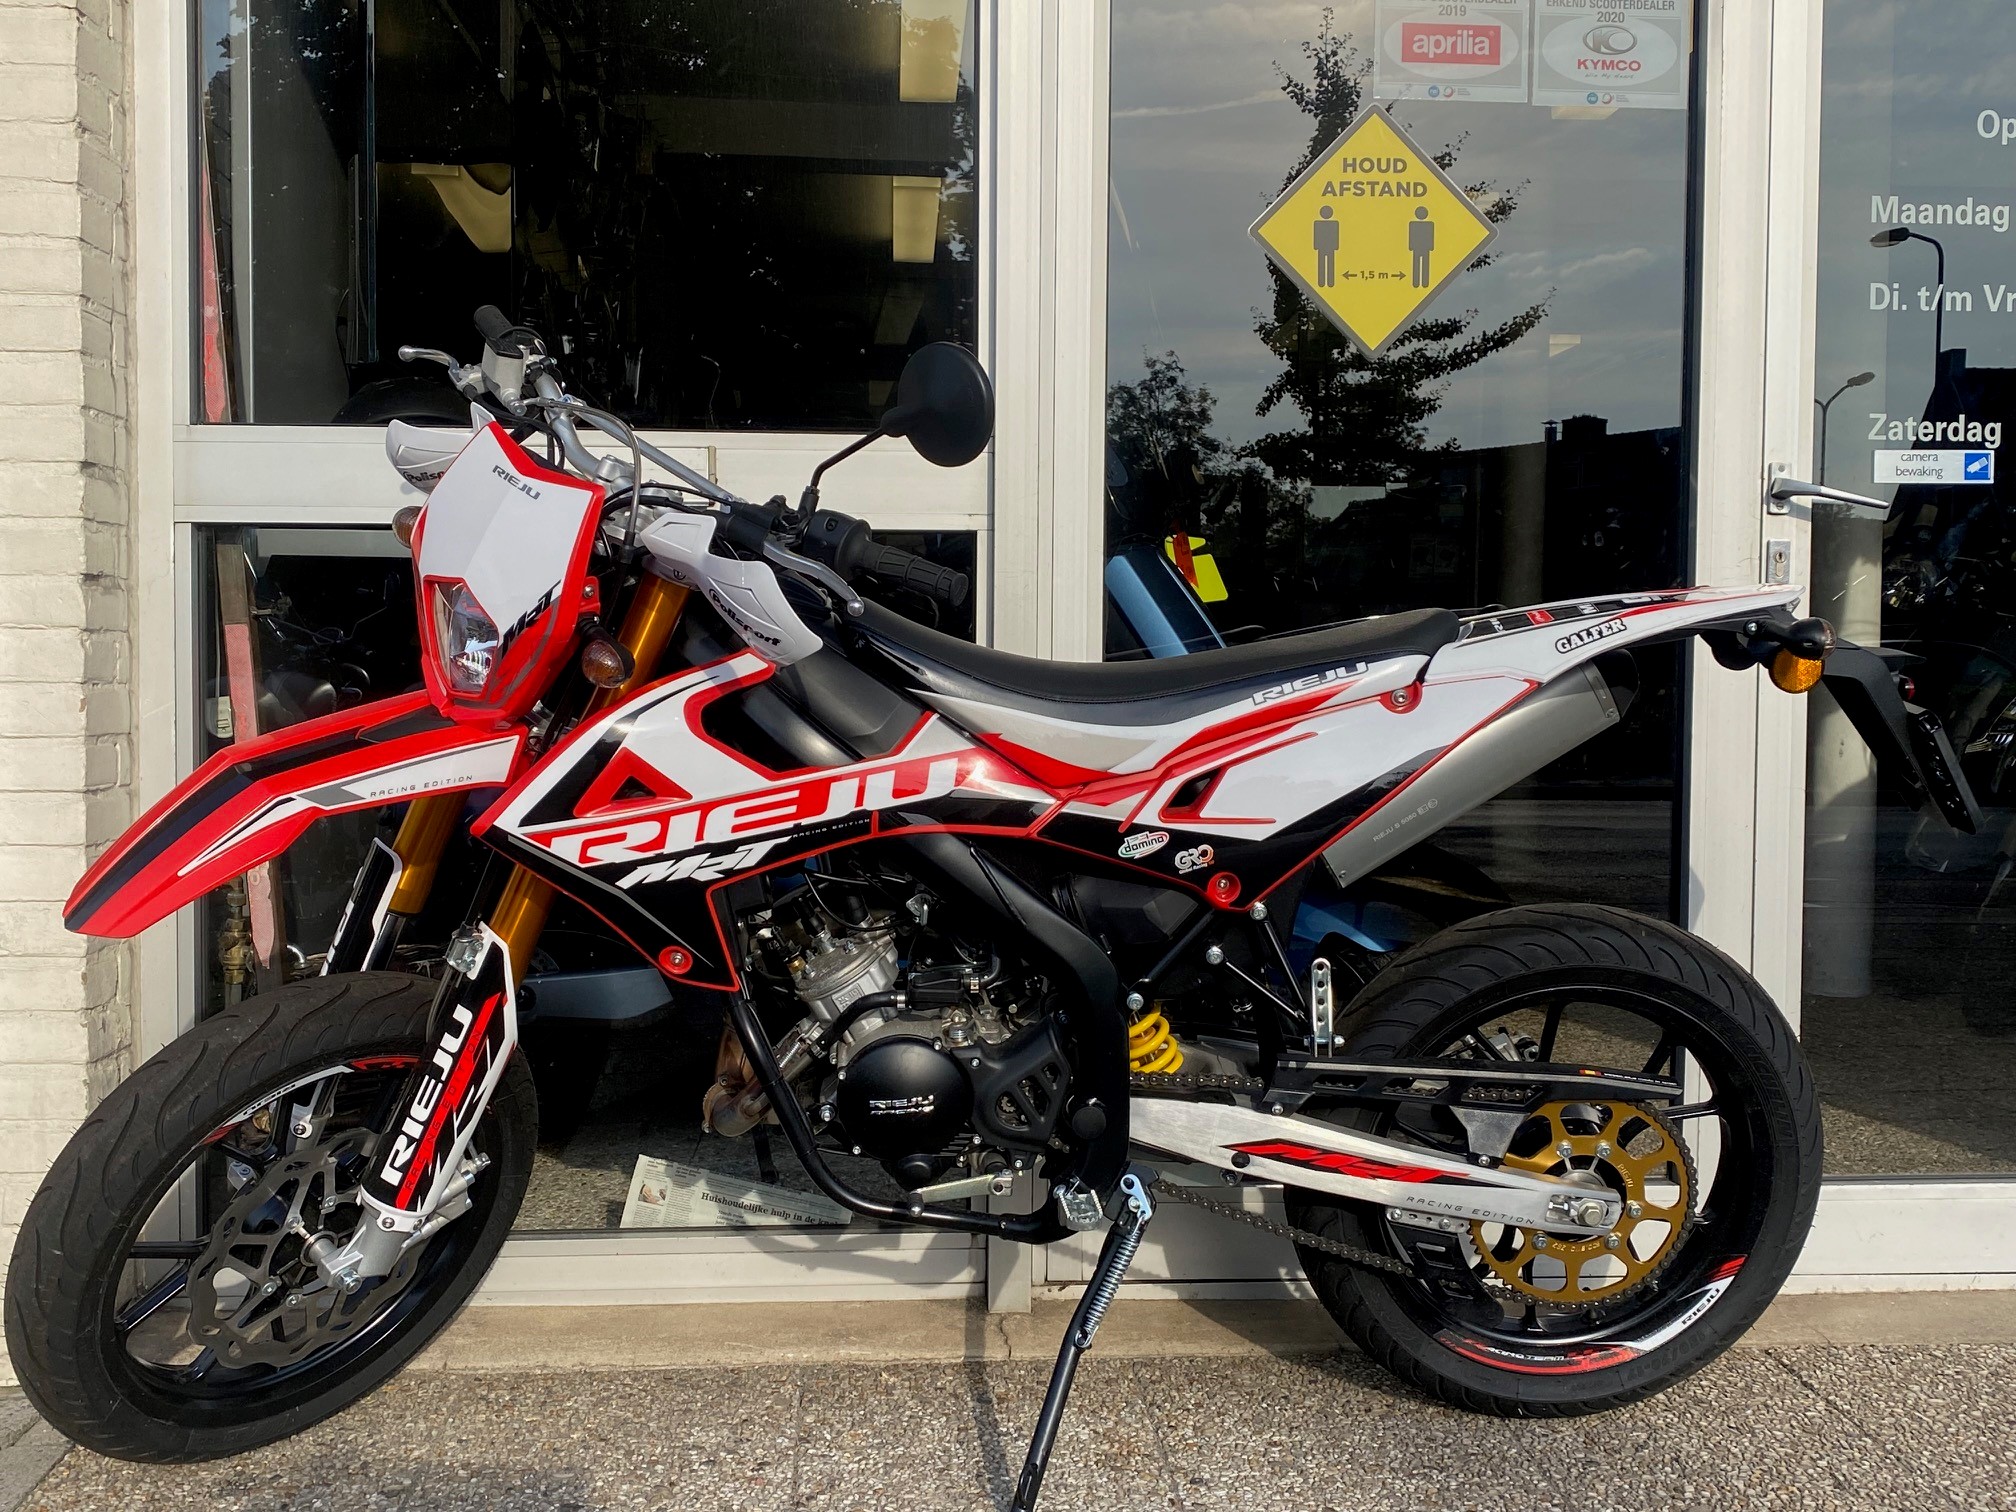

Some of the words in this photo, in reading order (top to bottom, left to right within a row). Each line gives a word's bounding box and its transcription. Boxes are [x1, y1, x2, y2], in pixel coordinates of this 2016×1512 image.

[1438, 4, 1467, 17] 2019
[1588, 0, 1675, 11] SCOOTERDEALER
[1596, 11, 1625, 23] 2020
[1412, 29, 1490, 58] aprilia
[1577, 58, 1642, 72] KYMCO
[1342, 157, 1408, 174] HOUD
[1321, 181, 1428, 198] AFSTAND
[1870, 195, 2010, 232] Maandag
[1360, 270, 1375, 280] 1,5
[1378, 271, 1389, 280] m
[1869, 282, 1908, 311] Di.
[1917, 283, 1973, 312] t/m
[1868, 413, 2002, 449] Zaterdag
[1900, 452, 1939, 462] camera
[492, 464, 541, 500] RIEJU
[1895, 465, 1943, 480] bewaking
[708, 587, 782, 647] Polisport
[1555, 618, 1627, 654] GALFER
[1251, 661, 1370, 706] RIEJU
[370, 784, 416, 798] RACING
[423, 775, 473, 789] EDITION
[548, 757, 960, 868] RIEJU
[1124, 833, 1165, 853] domino
[1174, 844, 1214, 870] GRO
[380, 1003, 473, 1187] RIEJU
[869, 1094, 934, 1109] RIEJU
[405, 1121, 441, 1190] RACING
[701, 1191, 769, 1214] Huishoudelijke
[770, 1207, 791, 1220] hulp
[793, 1212, 803, 1221] in
[804, 1215, 816, 1223] de
[1406, 1196, 1464, 1212] RACING
[1471, 1208, 1536, 1225] EDITION
[1681, 1287, 1721, 1326] RIEJU
